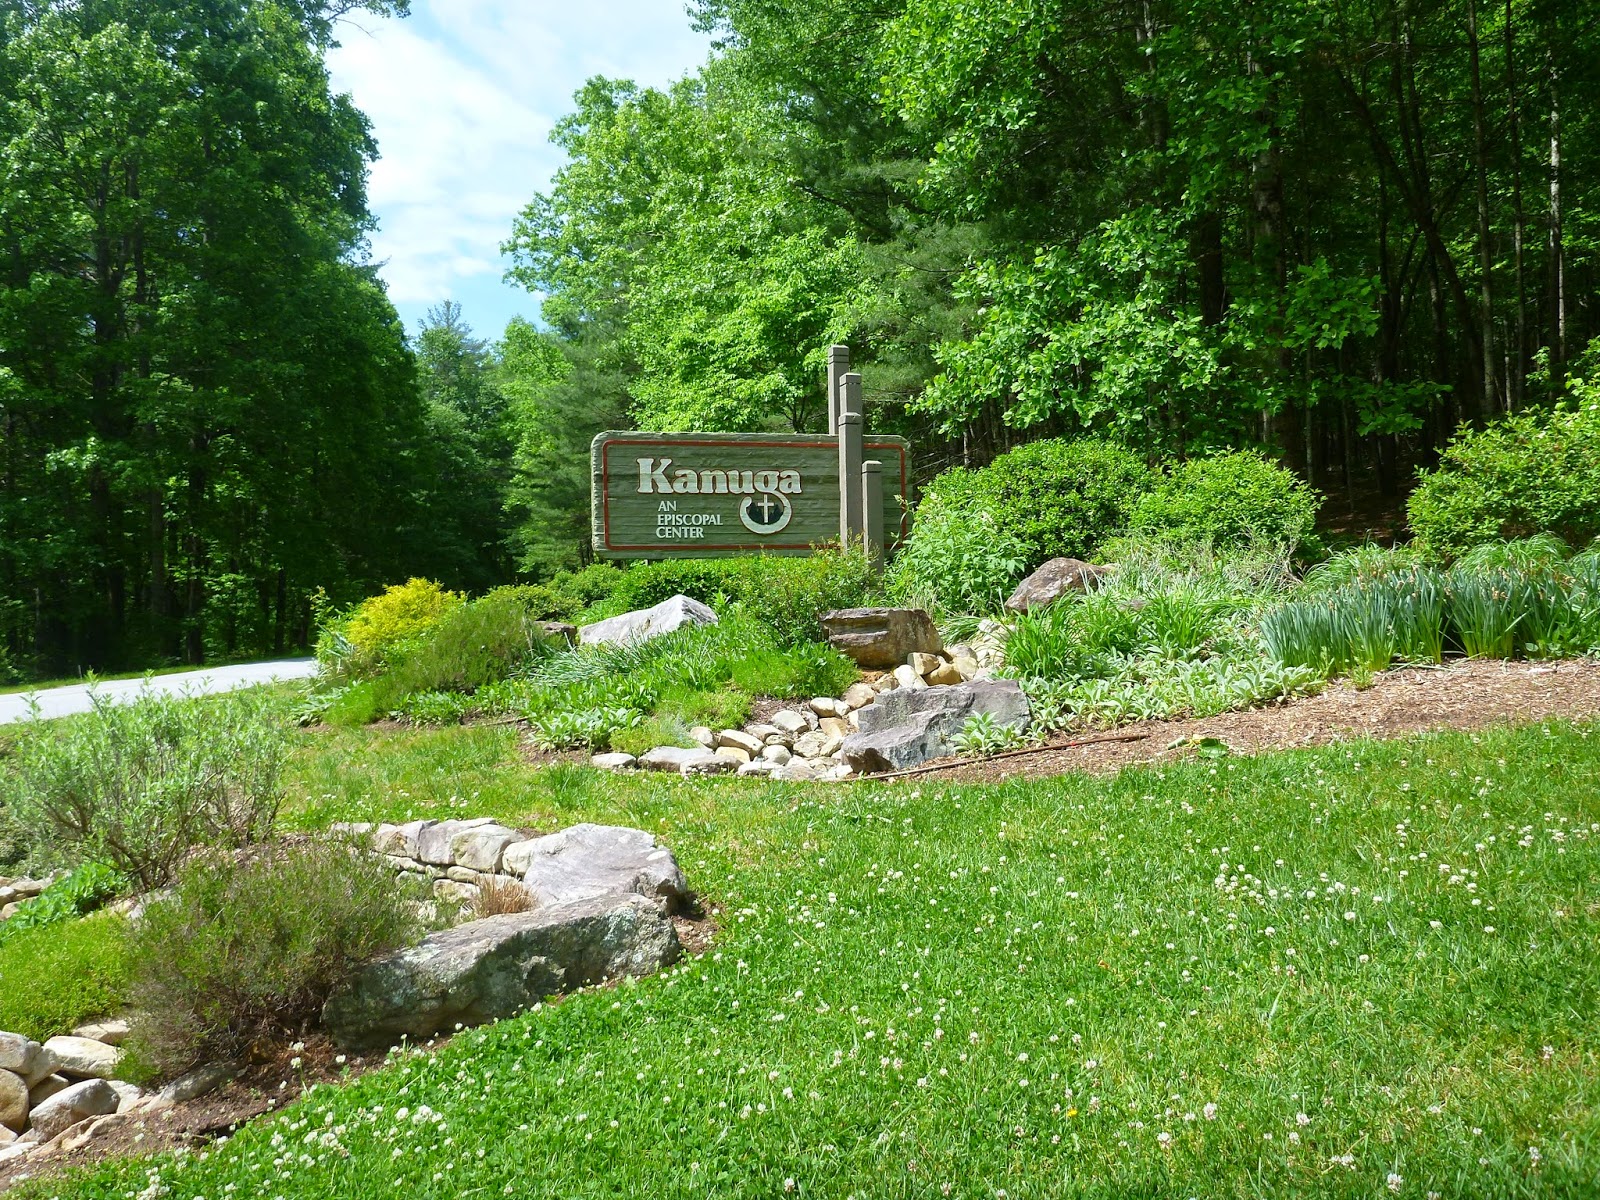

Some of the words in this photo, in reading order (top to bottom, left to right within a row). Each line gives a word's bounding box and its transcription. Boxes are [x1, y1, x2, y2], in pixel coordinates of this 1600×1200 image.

[658, 500, 677, 512] AN
[657, 514, 723, 526] EPISCOPAL
[656, 526, 704, 539] CENTER
